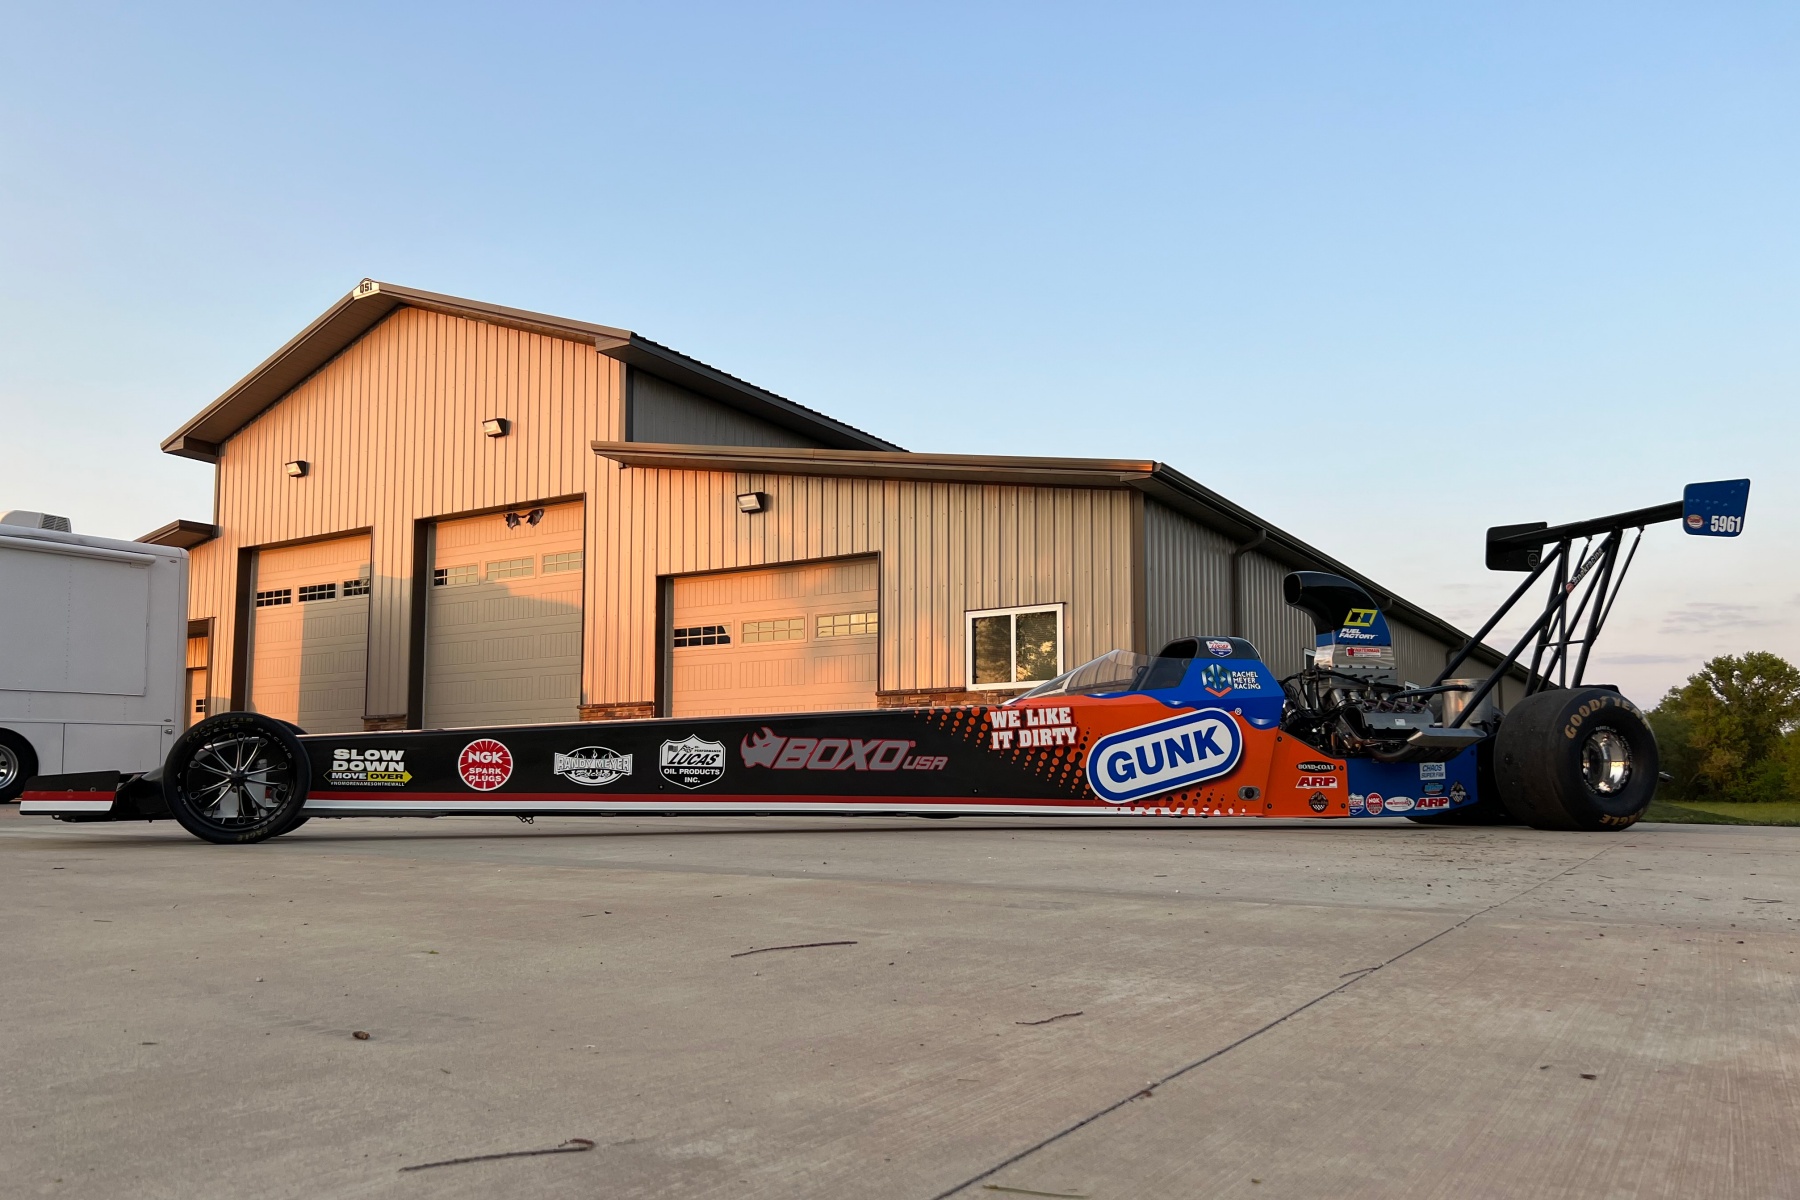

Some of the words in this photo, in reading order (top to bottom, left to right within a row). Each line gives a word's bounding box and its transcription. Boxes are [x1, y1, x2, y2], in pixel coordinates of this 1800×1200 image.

[1710, 515, 1742, 532] 5961
[990, 710, 1020, 729] WE
[1026, 706, 1072, 726] LIKE
[991, 731, 1014, 750] IT
[1019, 726, 1077, 748] DIRTY
[334, 749, 404, 760] SLOW
[468, 752, 504, 764] NGK
[772, 737, 910, 770] BOXO
[902, 756, 948, 770] USA
[1106, 725, 1225, 783] GUNK
[332, 760, 404, 772] DOWN
[558, 758, 592, 770] RANDY
[596, 758, 630, 770] MEYER
[667, 754, 720, 766] LUCAS
[1297, 777, 1336, 786] ARP
[1416, 798, 1448, 808] ARP
